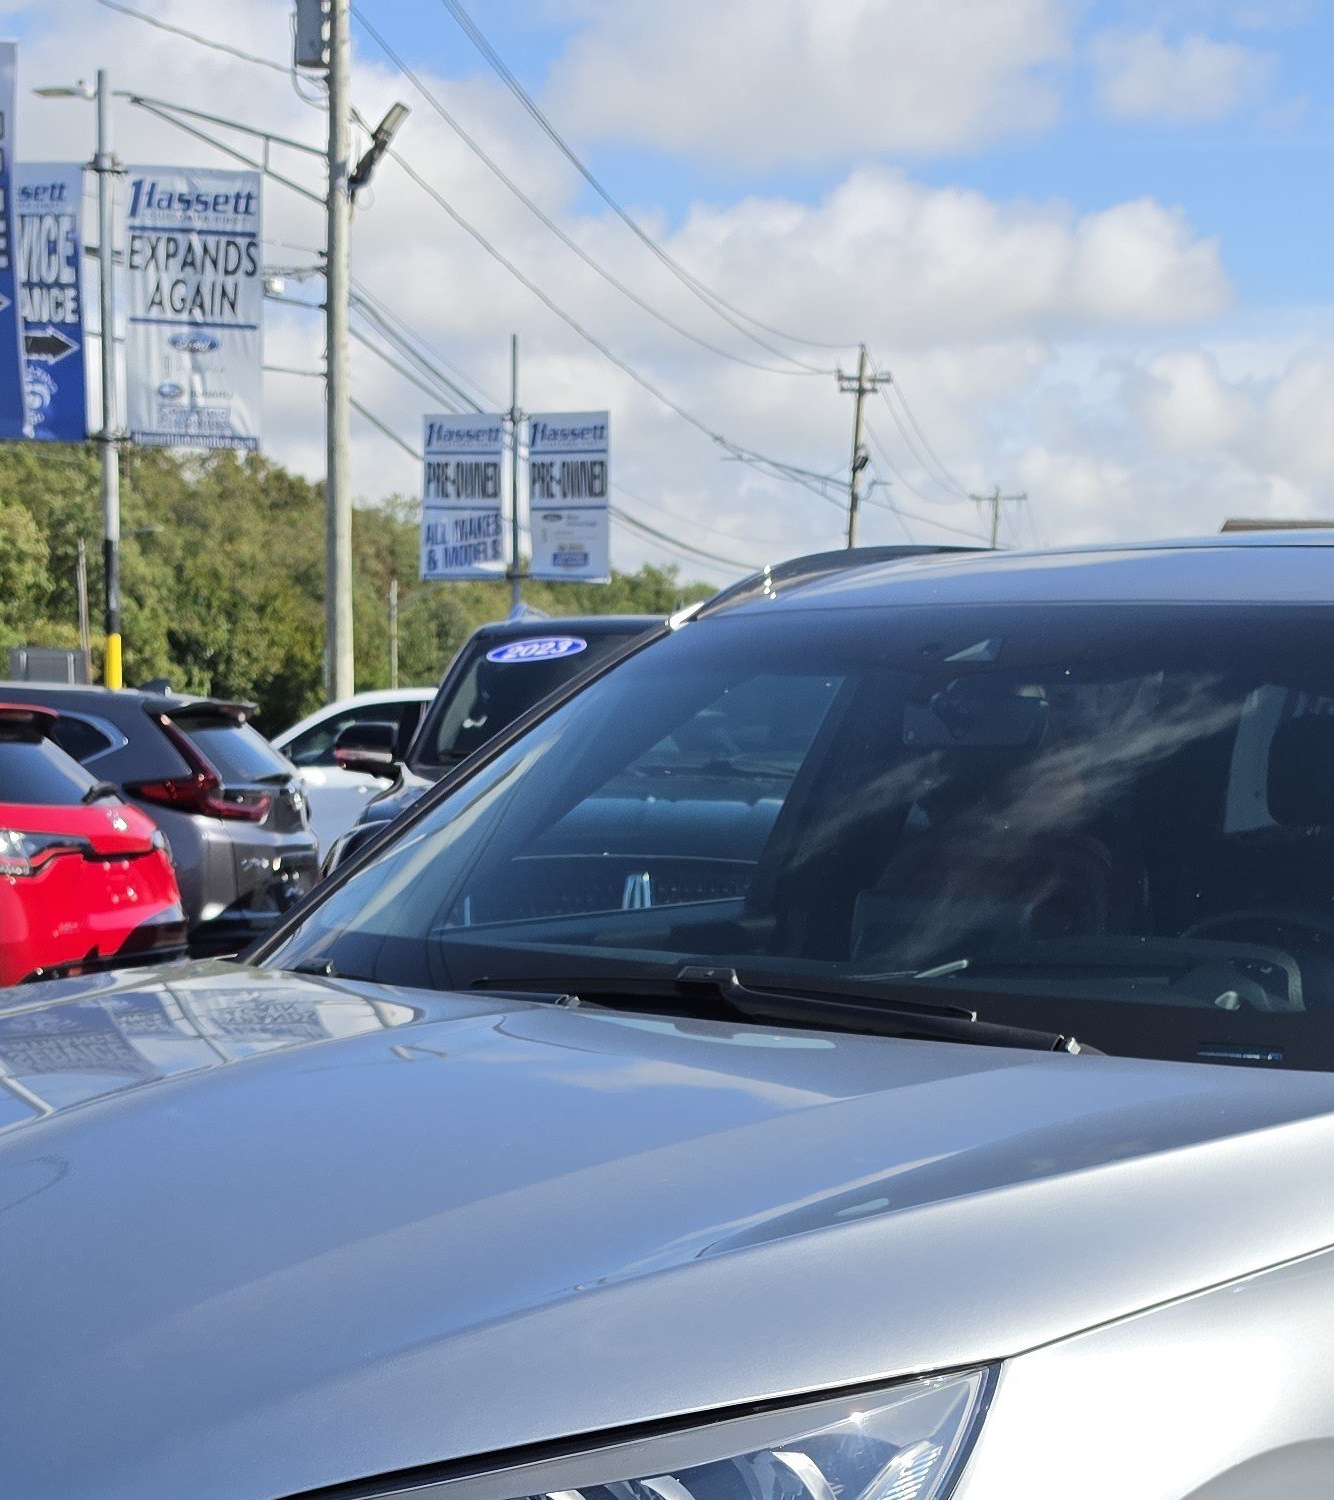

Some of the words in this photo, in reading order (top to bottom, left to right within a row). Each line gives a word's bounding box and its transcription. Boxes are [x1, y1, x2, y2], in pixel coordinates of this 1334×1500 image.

[20, 182, 67, 201] sett
[129, 179, 257, 217] Hassett
[19, 213, 76, 284] VICE
[129, 234, 259, 277] EXPANDS
[21, 286, 80, 323] ANCE
[148, 279, 238, 317] AGAIN
[427, 461, 501, 498] PRE-OWNED
[531, 461, 606, 498] PRE-OWNED
[426, 522, 448, 546] ALL
[454, 512, 501, 542] MAKES
[427, 552, 437, 571] &
[444, 538, 501, 568] MODELS
